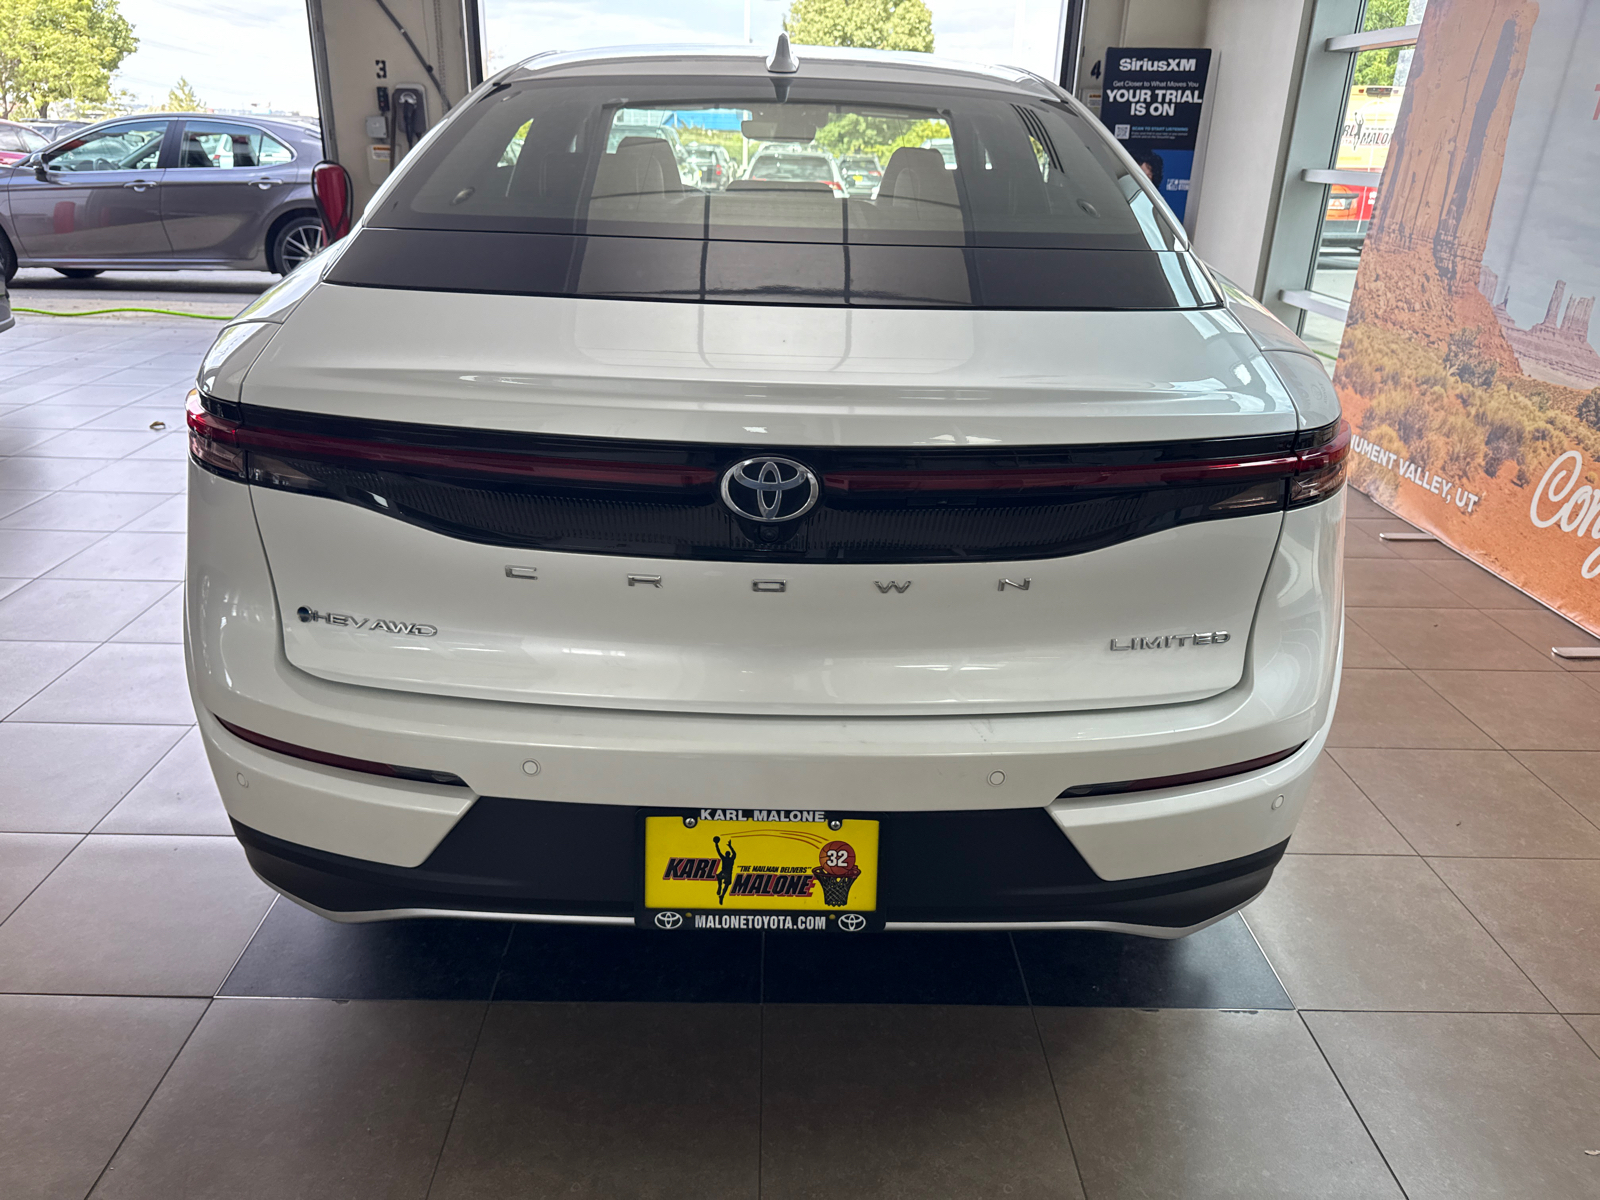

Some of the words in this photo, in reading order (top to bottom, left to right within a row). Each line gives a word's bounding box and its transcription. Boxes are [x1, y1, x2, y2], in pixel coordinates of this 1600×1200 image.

[375, 60, 387, 79] 3
[1090, 60, 1102, 80] 4
[1119, 58, 1197, 72] SiriusXM
[1113, 80, 1124, 88] Get
[1106, 89, 1152, 103] YOUR
[1154, 90, 1203, 104] TRIAL
[1130, 102, 1147, 116] IS
[1149, 103, 1176, 117] ON
[1399, 461, 1453, 504] VALLEY,
[1455, 487, 1479, 513] UT
[505, 564, 1031, 593] CROWN
[368, 618, 438, 638] AWD
[1109, 629, 1232, 652] LIMITED
[700, 808, 747, 822] KARL
[753, 810, 826, 823] MALONE
[826, 849, 848, 868] 32
[662, 857, 722, 881] KARL
[729, 873, 817, 898] MALONE
[694, 914, 827, 931] MALONETOYOTA.COM
